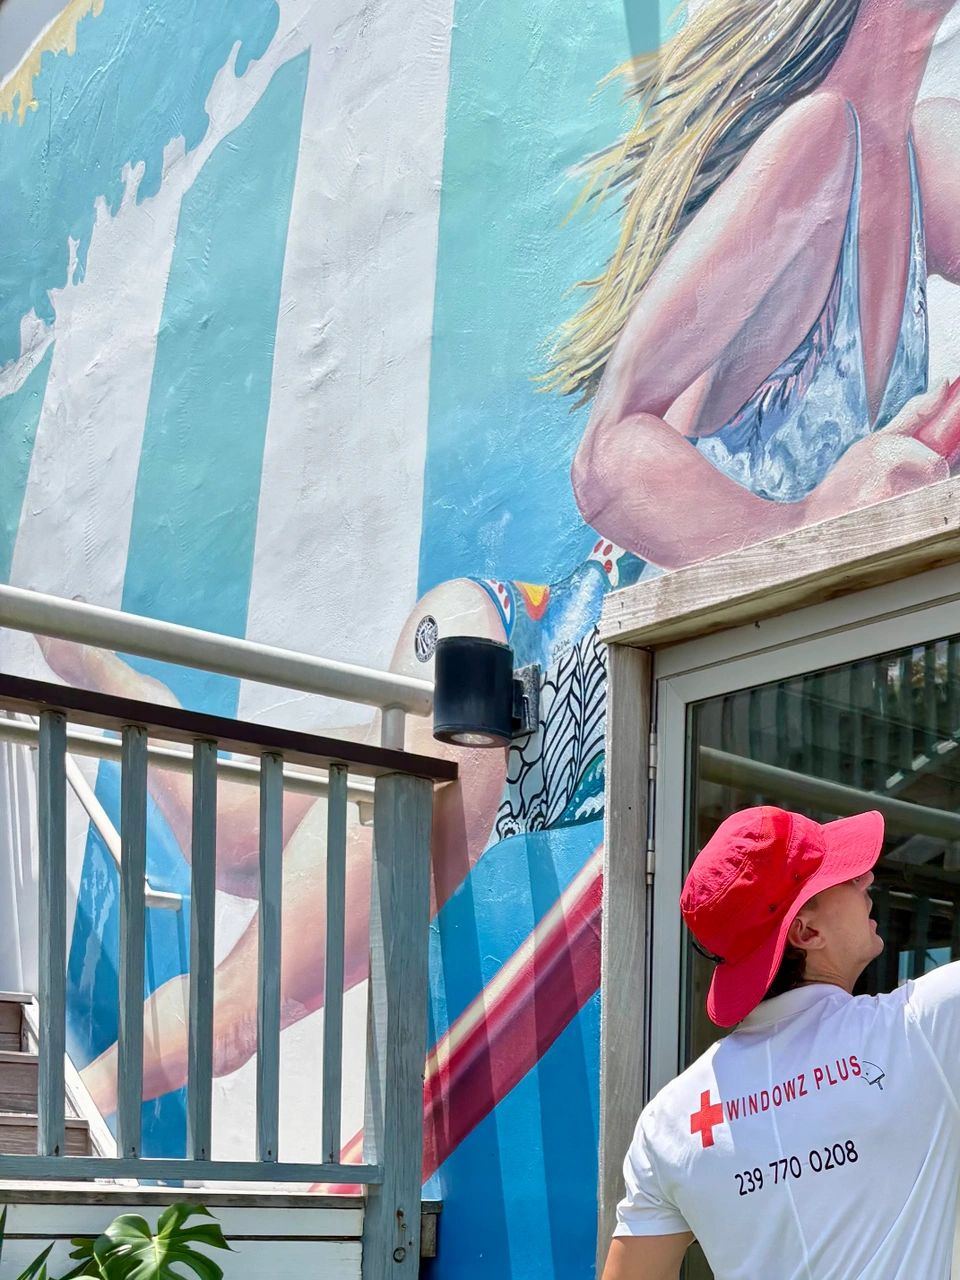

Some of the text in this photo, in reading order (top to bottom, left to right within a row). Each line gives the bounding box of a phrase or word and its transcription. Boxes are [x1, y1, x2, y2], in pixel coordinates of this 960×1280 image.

[726, 1055, 861, 1121] WINDOWZ PLUS
[734, 1140, 859, 1196] 239 770 0208
